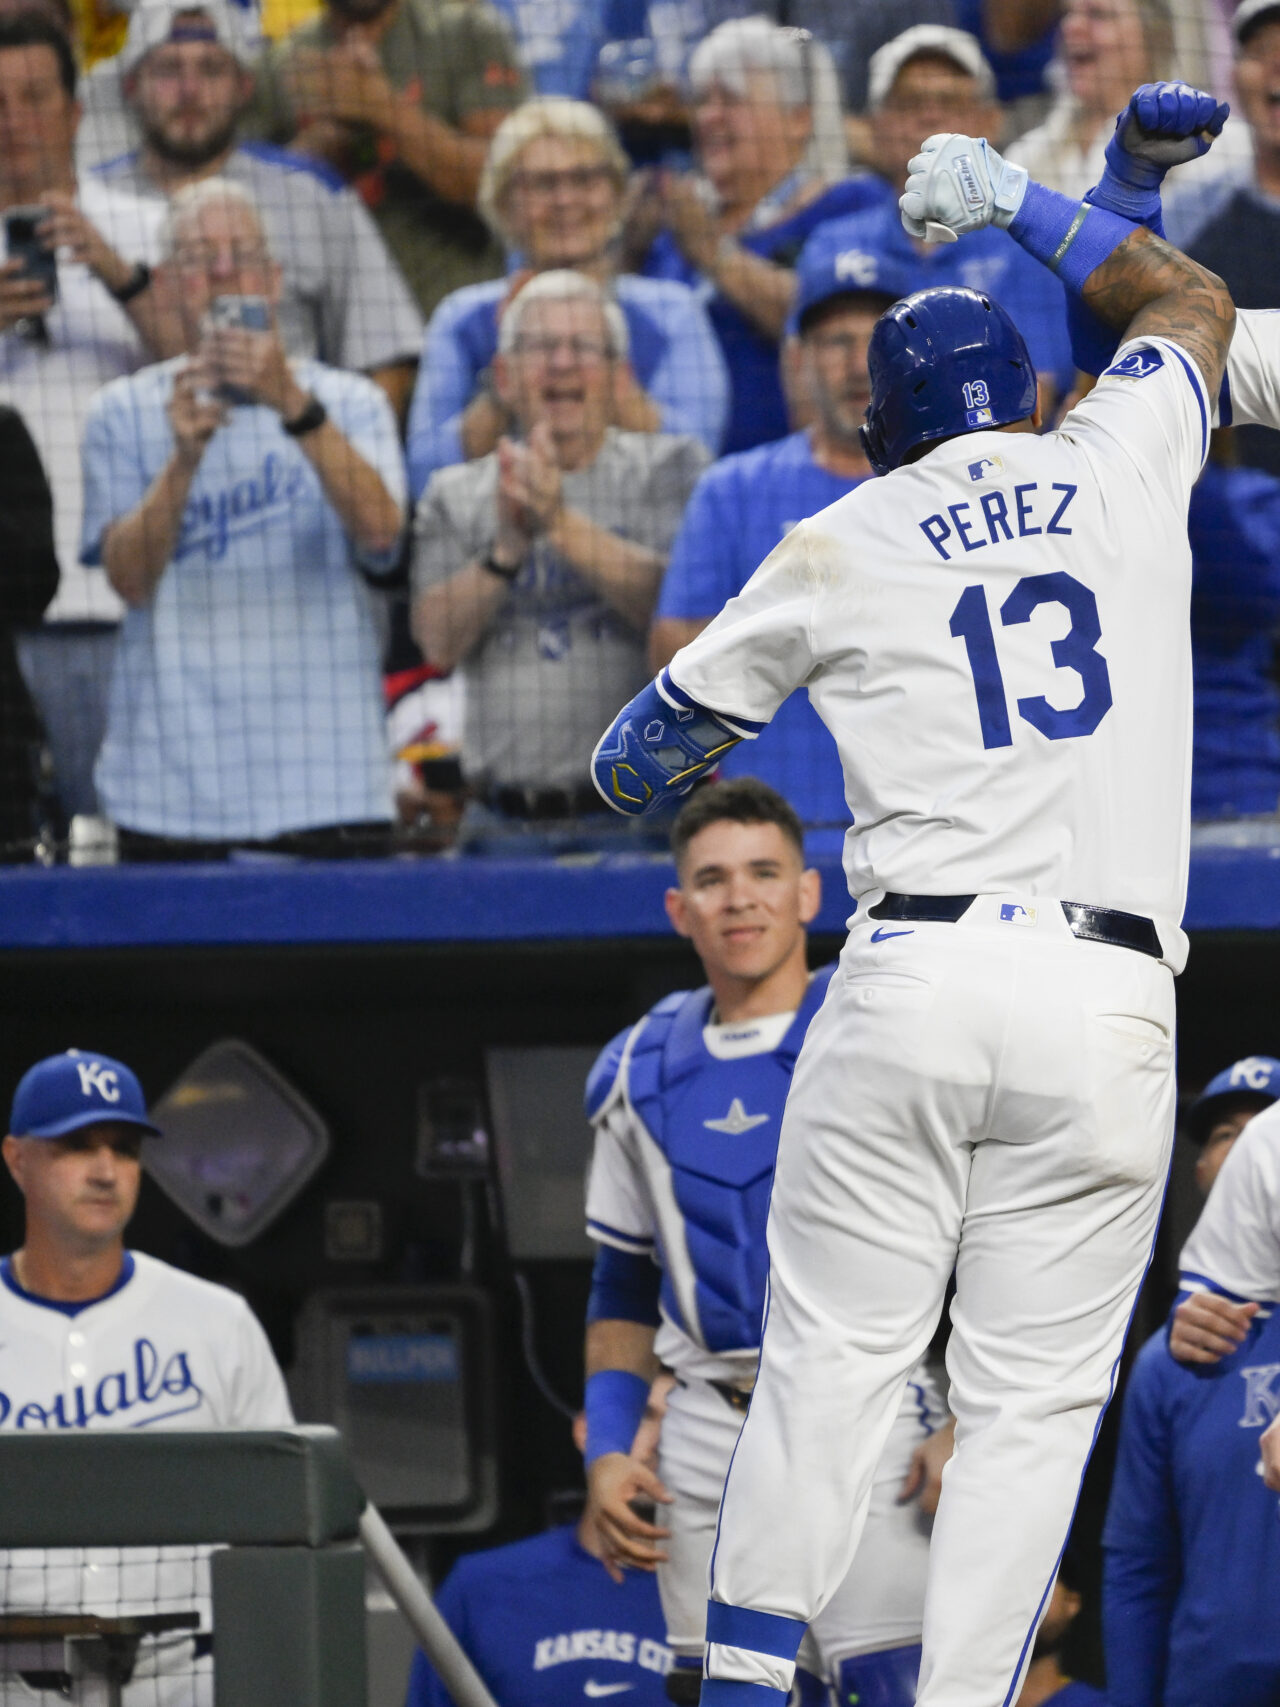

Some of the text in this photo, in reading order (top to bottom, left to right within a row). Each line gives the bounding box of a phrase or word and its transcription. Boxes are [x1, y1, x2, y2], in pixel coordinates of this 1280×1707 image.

[963, 380, 990, 409] 13
[919, 482, 1078, 561] PEREZ
[949, 571, 1113, 750] 13
[77, 1062, 120, 1102] KC
[1229, 1056, 1272, 1089] KC
[0, 1338, 204, 1429] oyals
[533, 1629, 676, 1676] KANSAS CIT
